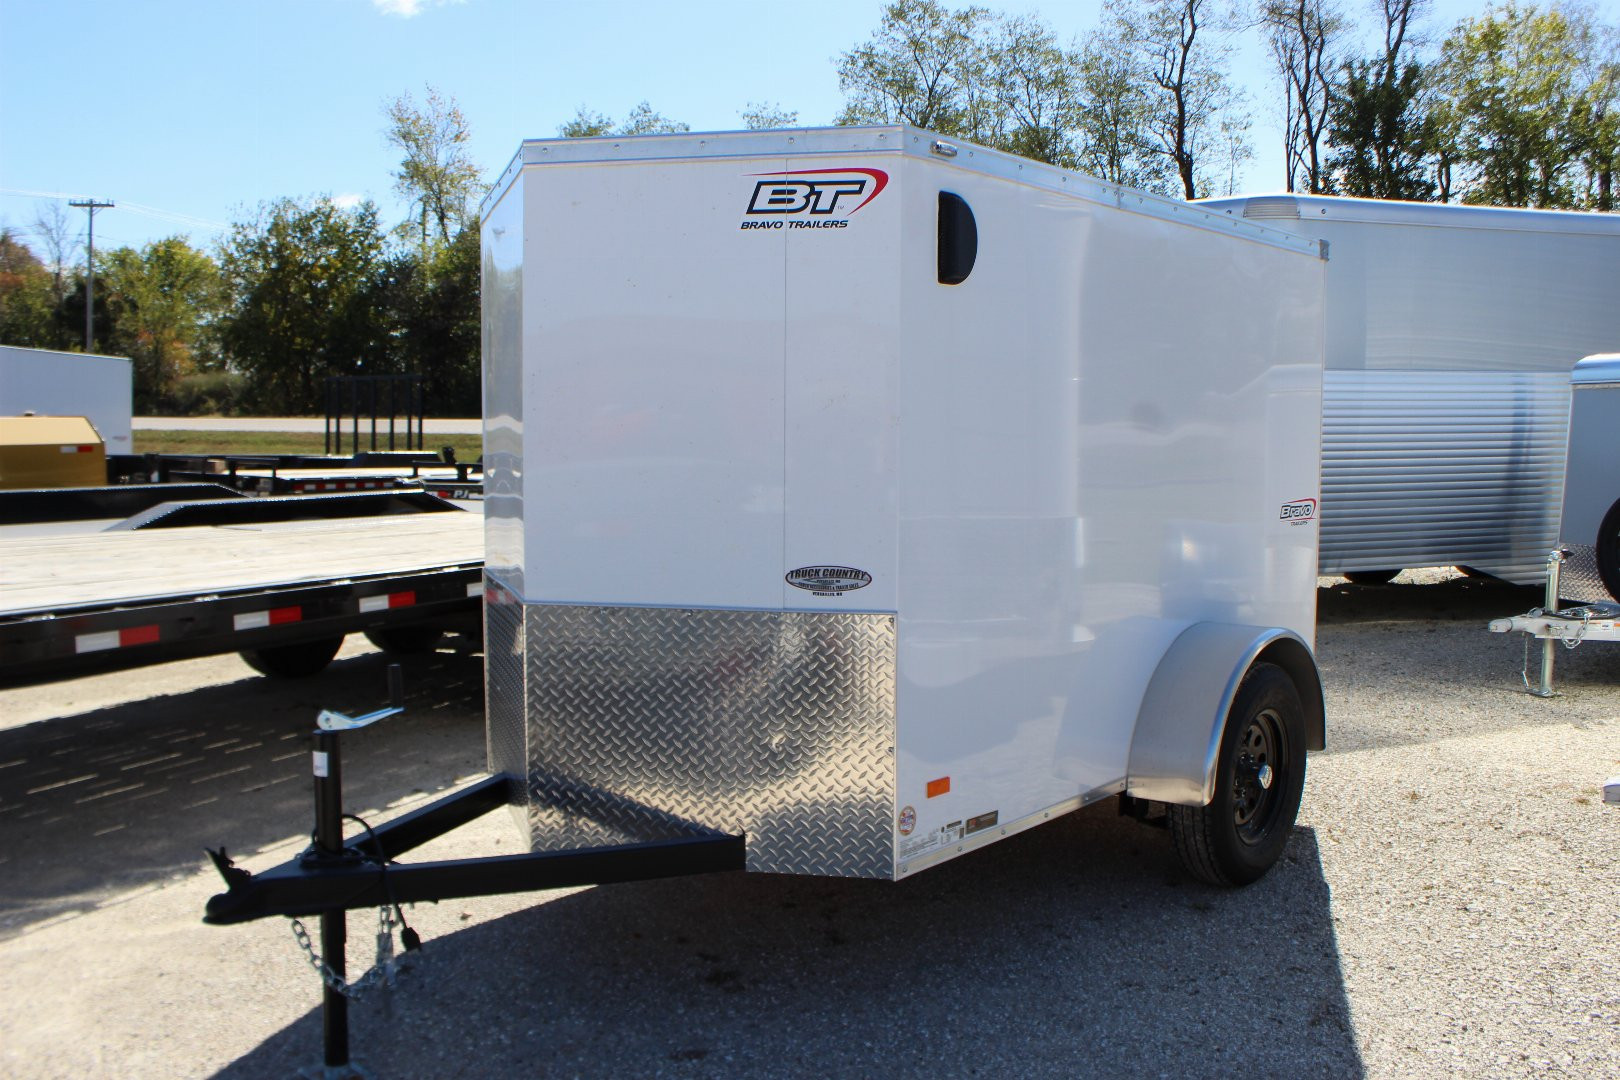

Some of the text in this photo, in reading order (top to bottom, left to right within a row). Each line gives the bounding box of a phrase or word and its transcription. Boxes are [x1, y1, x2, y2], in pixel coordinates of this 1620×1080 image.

[745, 179, 867, 215] BT
[740, 219, 849, 230] BRAVO TRAILERS
[1280, 504, 1312, 519] Bravo
[790, 569, 866, 580] TRUCK COUNTRY
